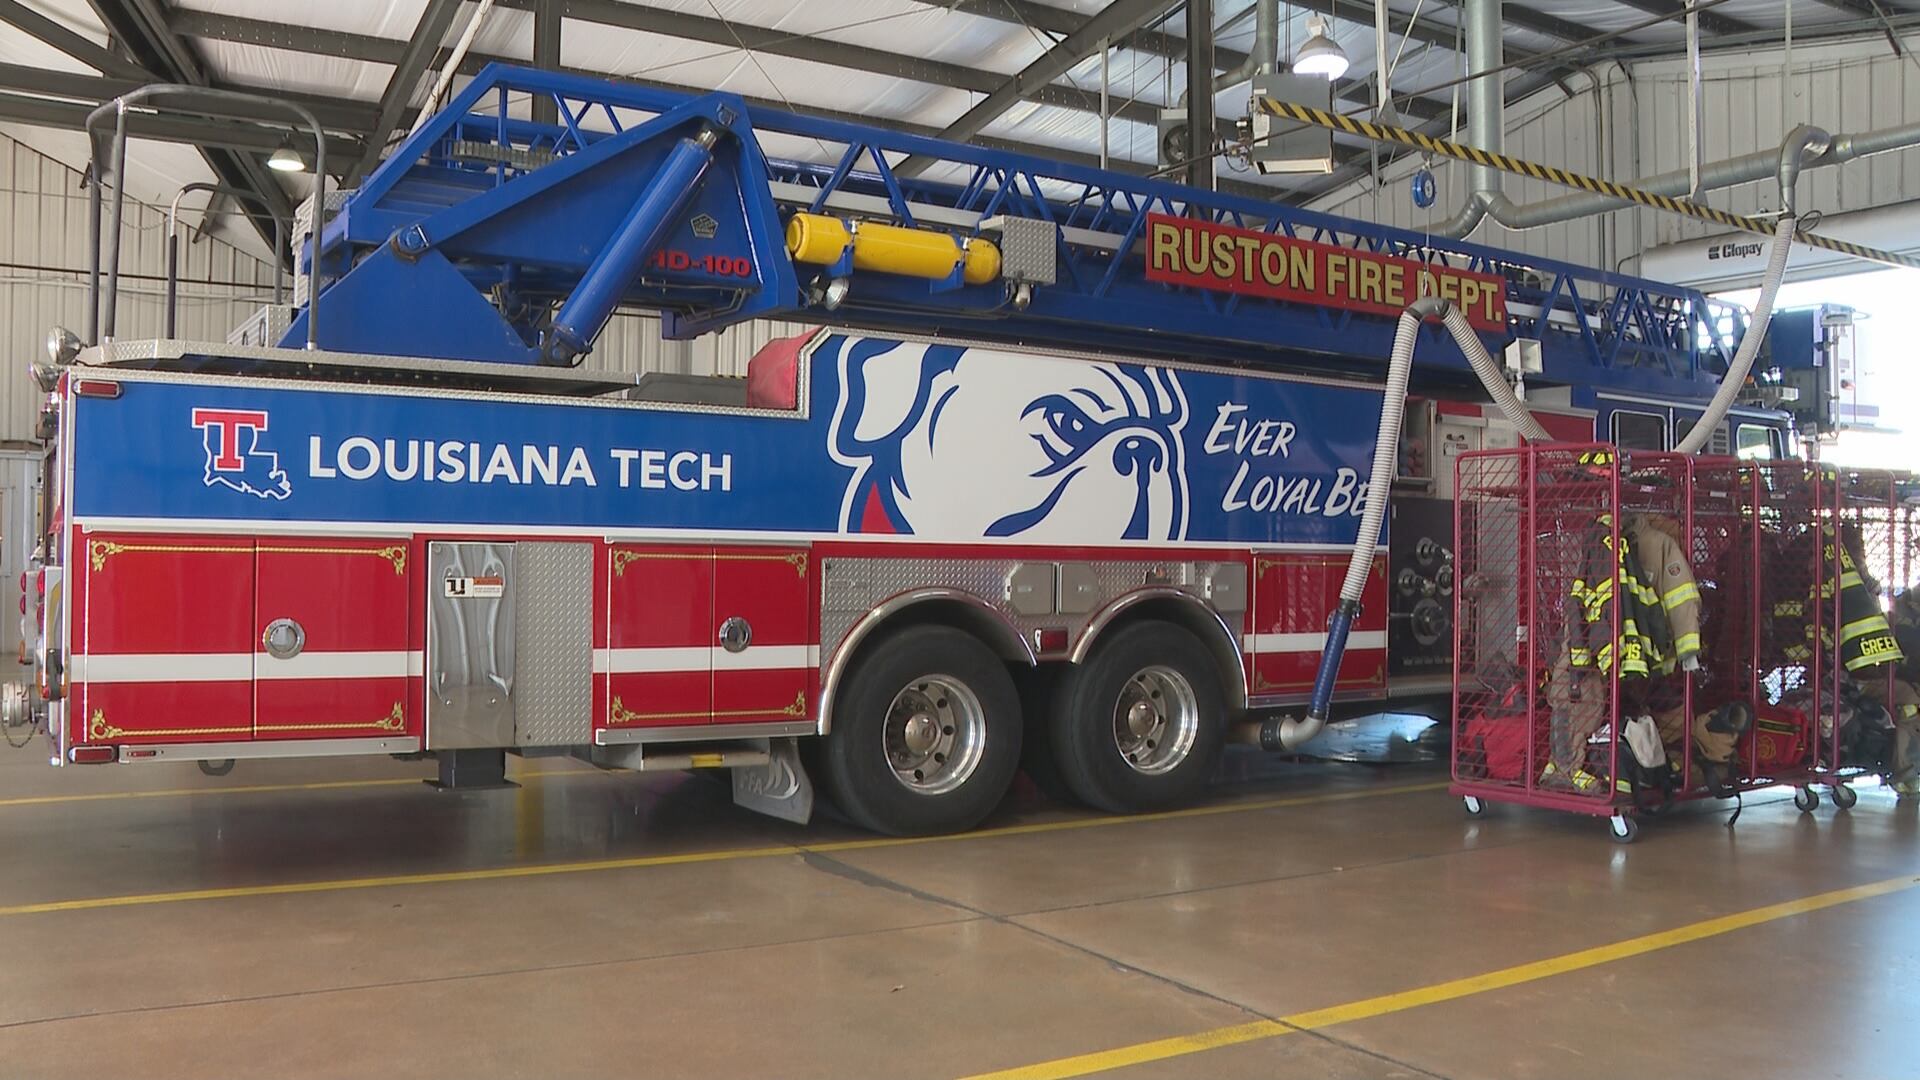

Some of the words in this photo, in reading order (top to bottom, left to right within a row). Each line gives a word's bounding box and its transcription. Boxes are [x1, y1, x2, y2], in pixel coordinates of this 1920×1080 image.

[1153, 223, 1315, 292] RUSTON
[1327, 253, 1405, 306] FIRE
[1416, 269, 1503, 322] DEPT.
[1723, 242, 1765, 258] Clopay
[1203, 400, 1296, 458] EVER
[309, 436, 597, 487] LOUISIANA
[610, 449, 732, 491] TECH
[1221, 459, 1322, 515] LOYAL
